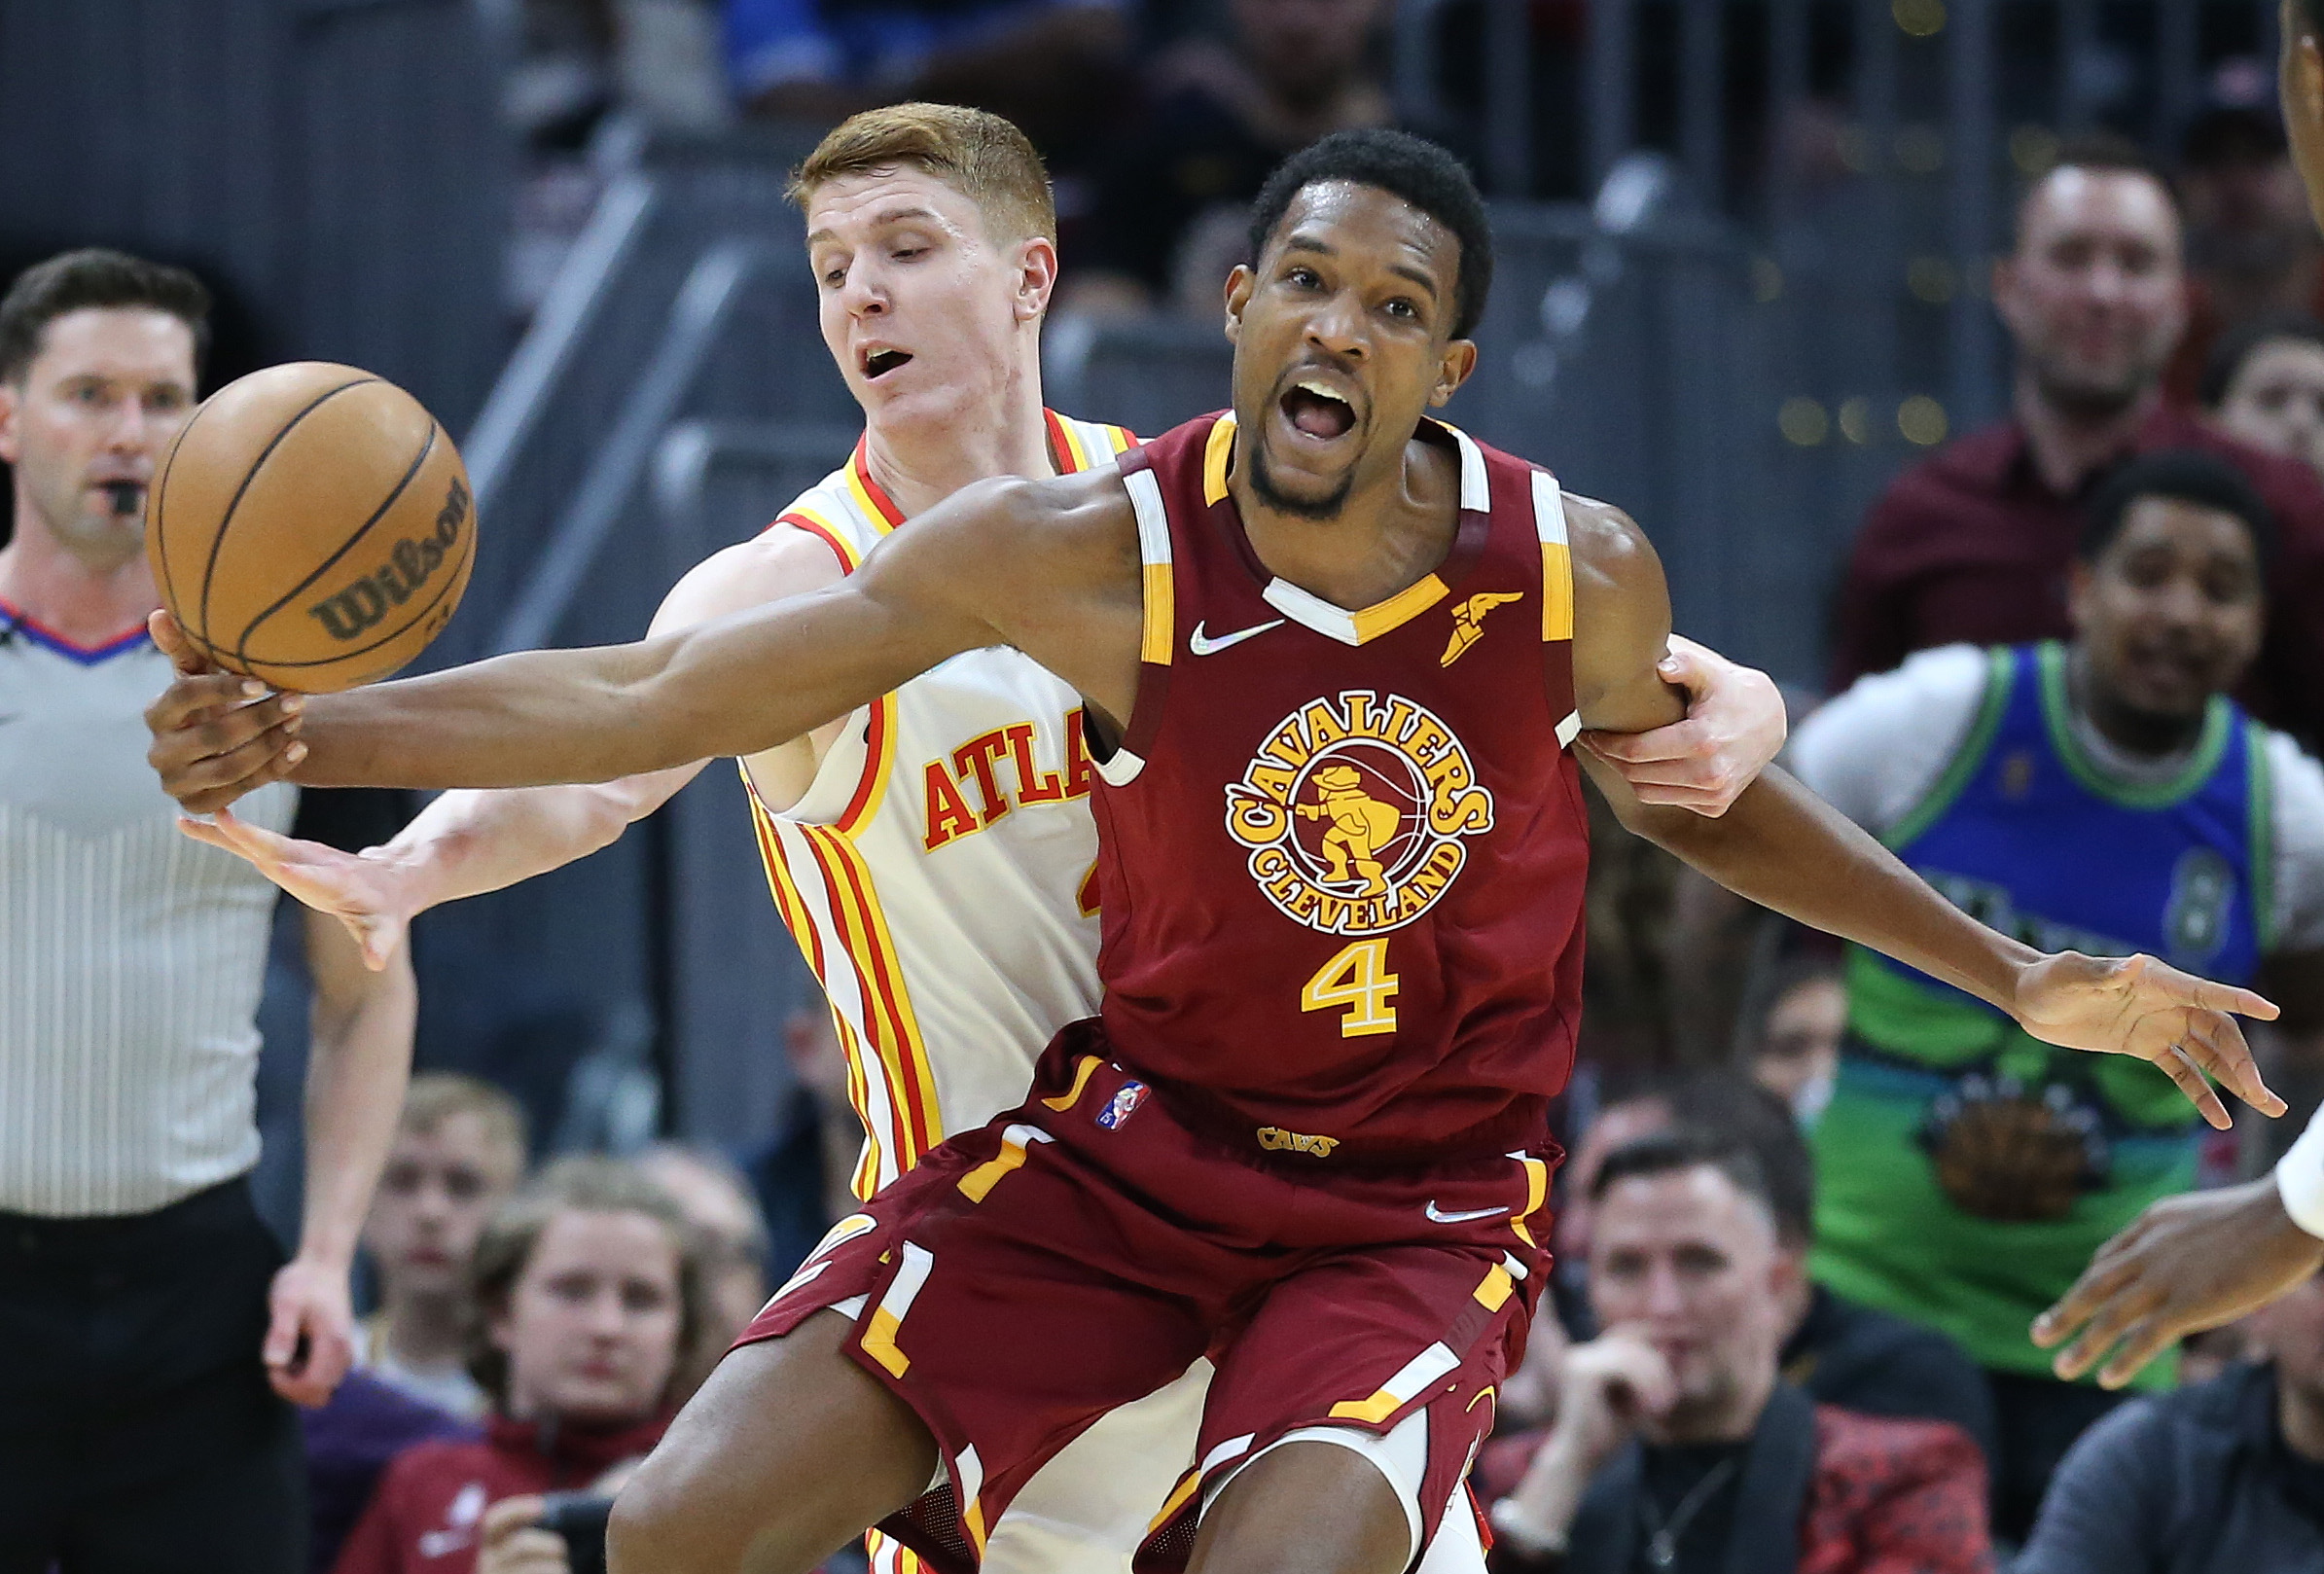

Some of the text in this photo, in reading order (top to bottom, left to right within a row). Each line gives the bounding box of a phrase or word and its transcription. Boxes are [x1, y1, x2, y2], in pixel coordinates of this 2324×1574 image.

[307, 476, 468, 640] Wilson
[1225, 690, 1494, 843] CAVALIERS
[1249, 841, 1465, 935] CLEVELAND
[1301, 938, 1398, 1037] 4
[1257, 1127, 1340, 1158] CAVS
